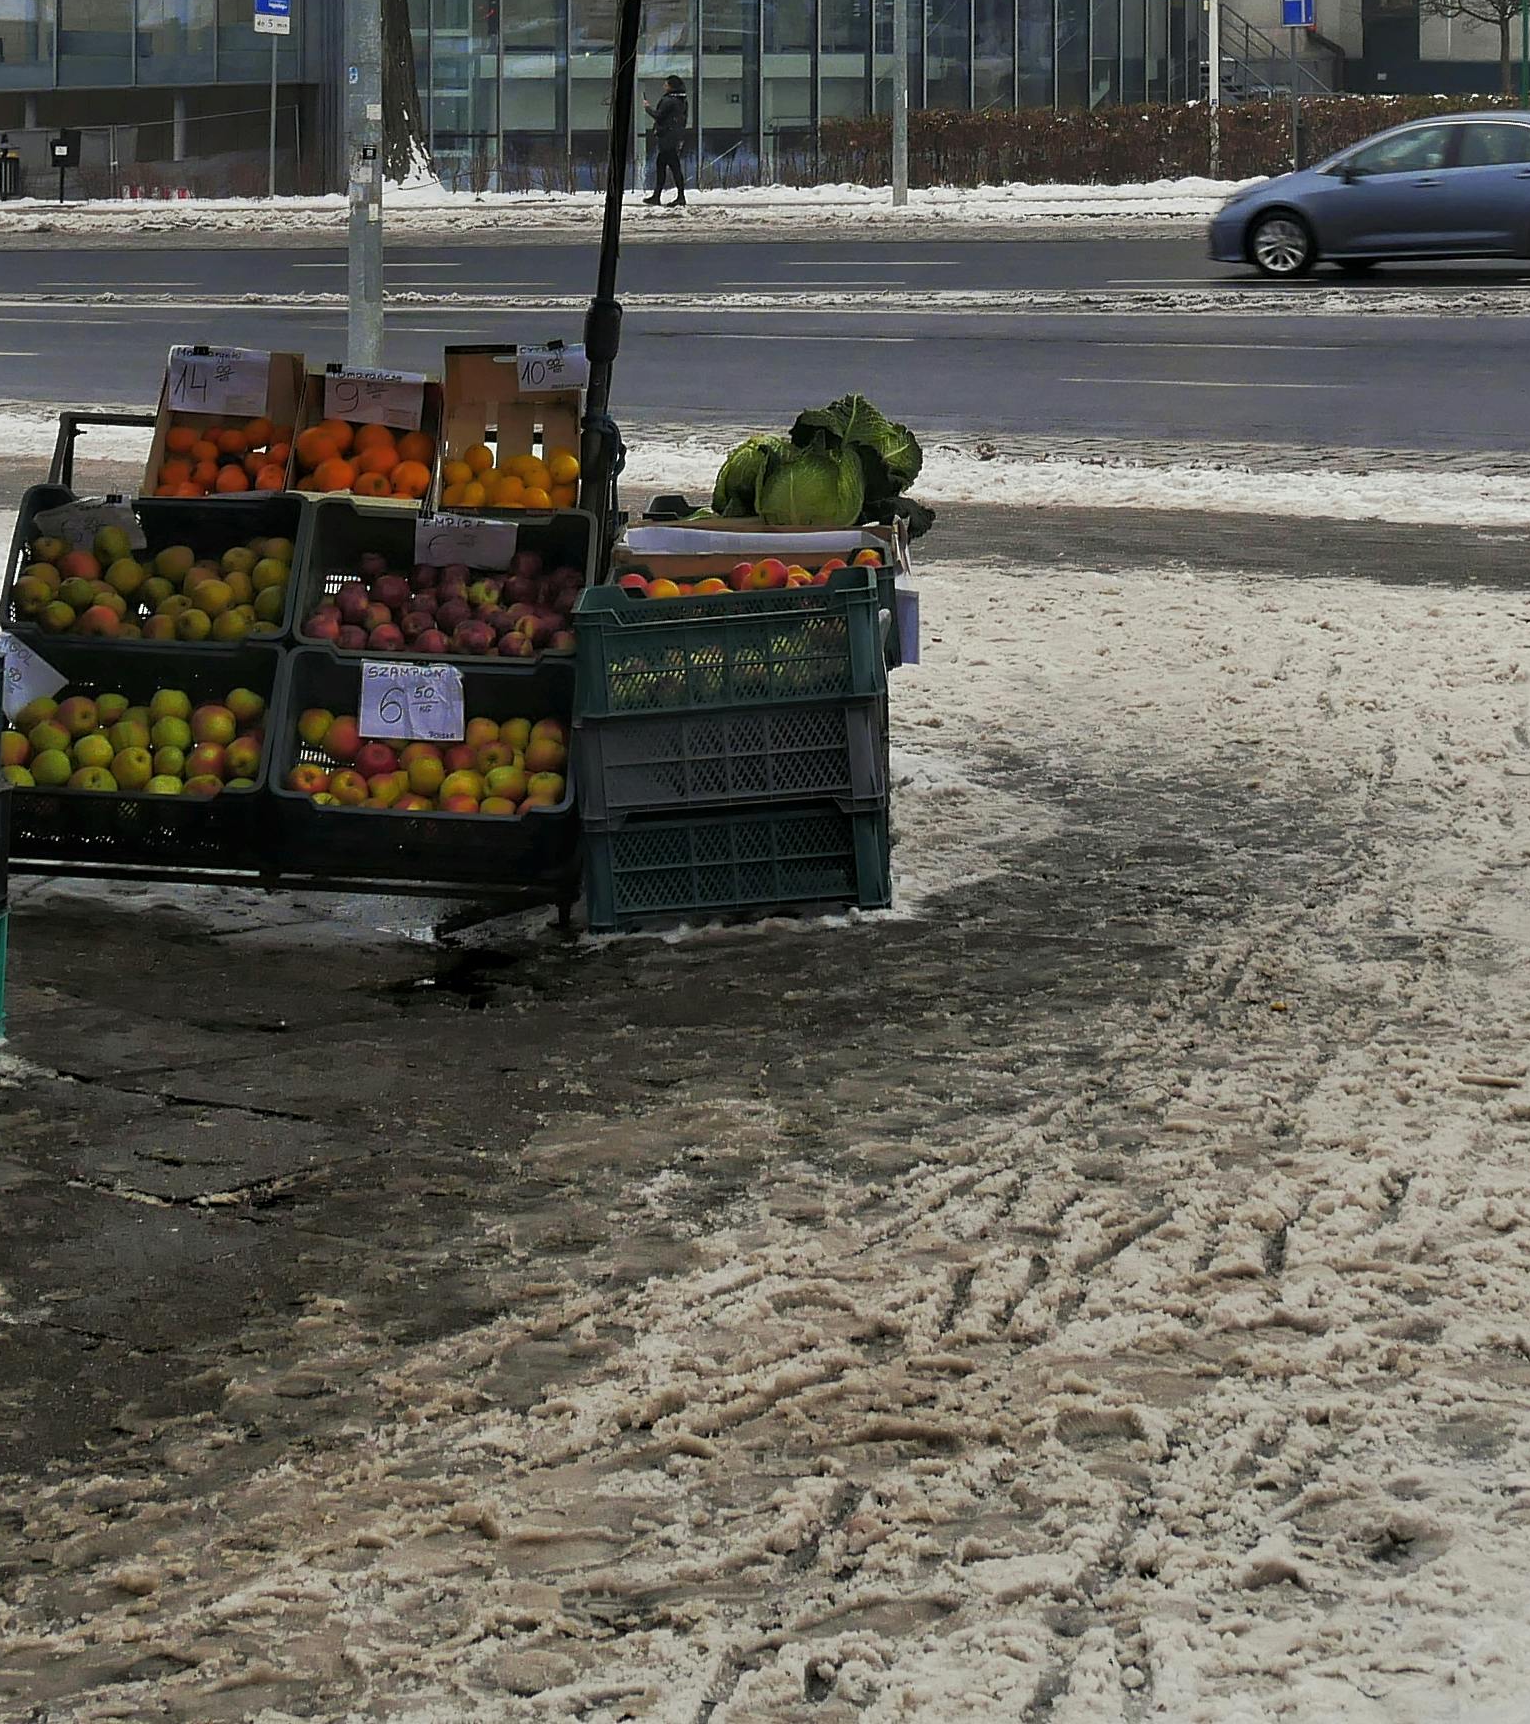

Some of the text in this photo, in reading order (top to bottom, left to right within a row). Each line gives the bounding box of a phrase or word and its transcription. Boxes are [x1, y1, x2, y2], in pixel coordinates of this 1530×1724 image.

[177, 347, 242, 364] Maarynki
[174, 363, 207, 403] 14
[521, 360, 546, 385] 10
[335, 381, 359, 413] 9
[379, 685, 436, 724] 6 50
